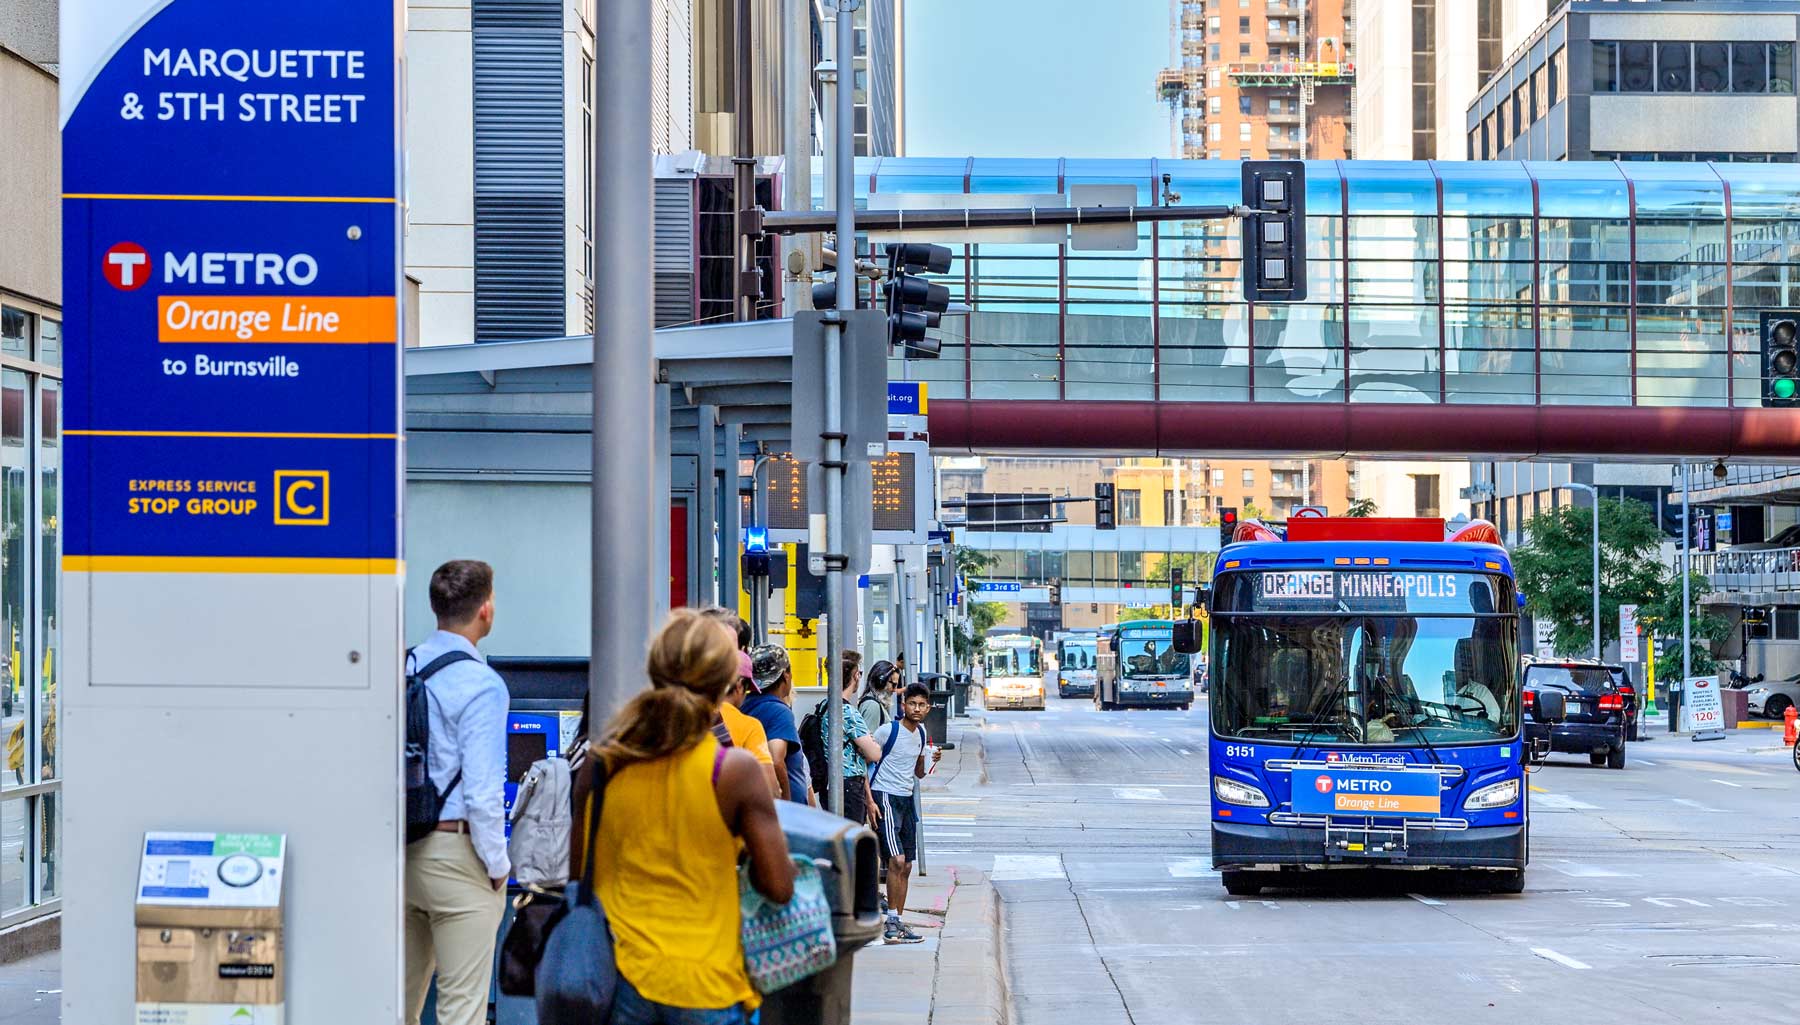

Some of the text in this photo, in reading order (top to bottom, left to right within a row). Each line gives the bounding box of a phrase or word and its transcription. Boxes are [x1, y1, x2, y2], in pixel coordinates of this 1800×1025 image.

[143, 48, 365, 82] MARQUETTE
[120, 92, 366, 123] & 5TH STREET
[164, 251, 318, 286] METRO
[166, 300, 340, 340] Orange Line
[162, 354, 299, 377] to Burnsville
[129, 479, 256, 493] EXPRESS SERVICE
[286, 480, 316, 515] C
[128, 497, 257, 515] STOP GROUP
[994, 583, 1007, 591] 3rd
[1010, 583, 1019, 591] St
[1265, 573, 1456, 597] ORANGE MINNEAPOLIS
[1226, 745, 1255, 758] 8151
[1337, 778, 1392, 792] METRO
[1337, 796, 1400, 810] Orange Line
